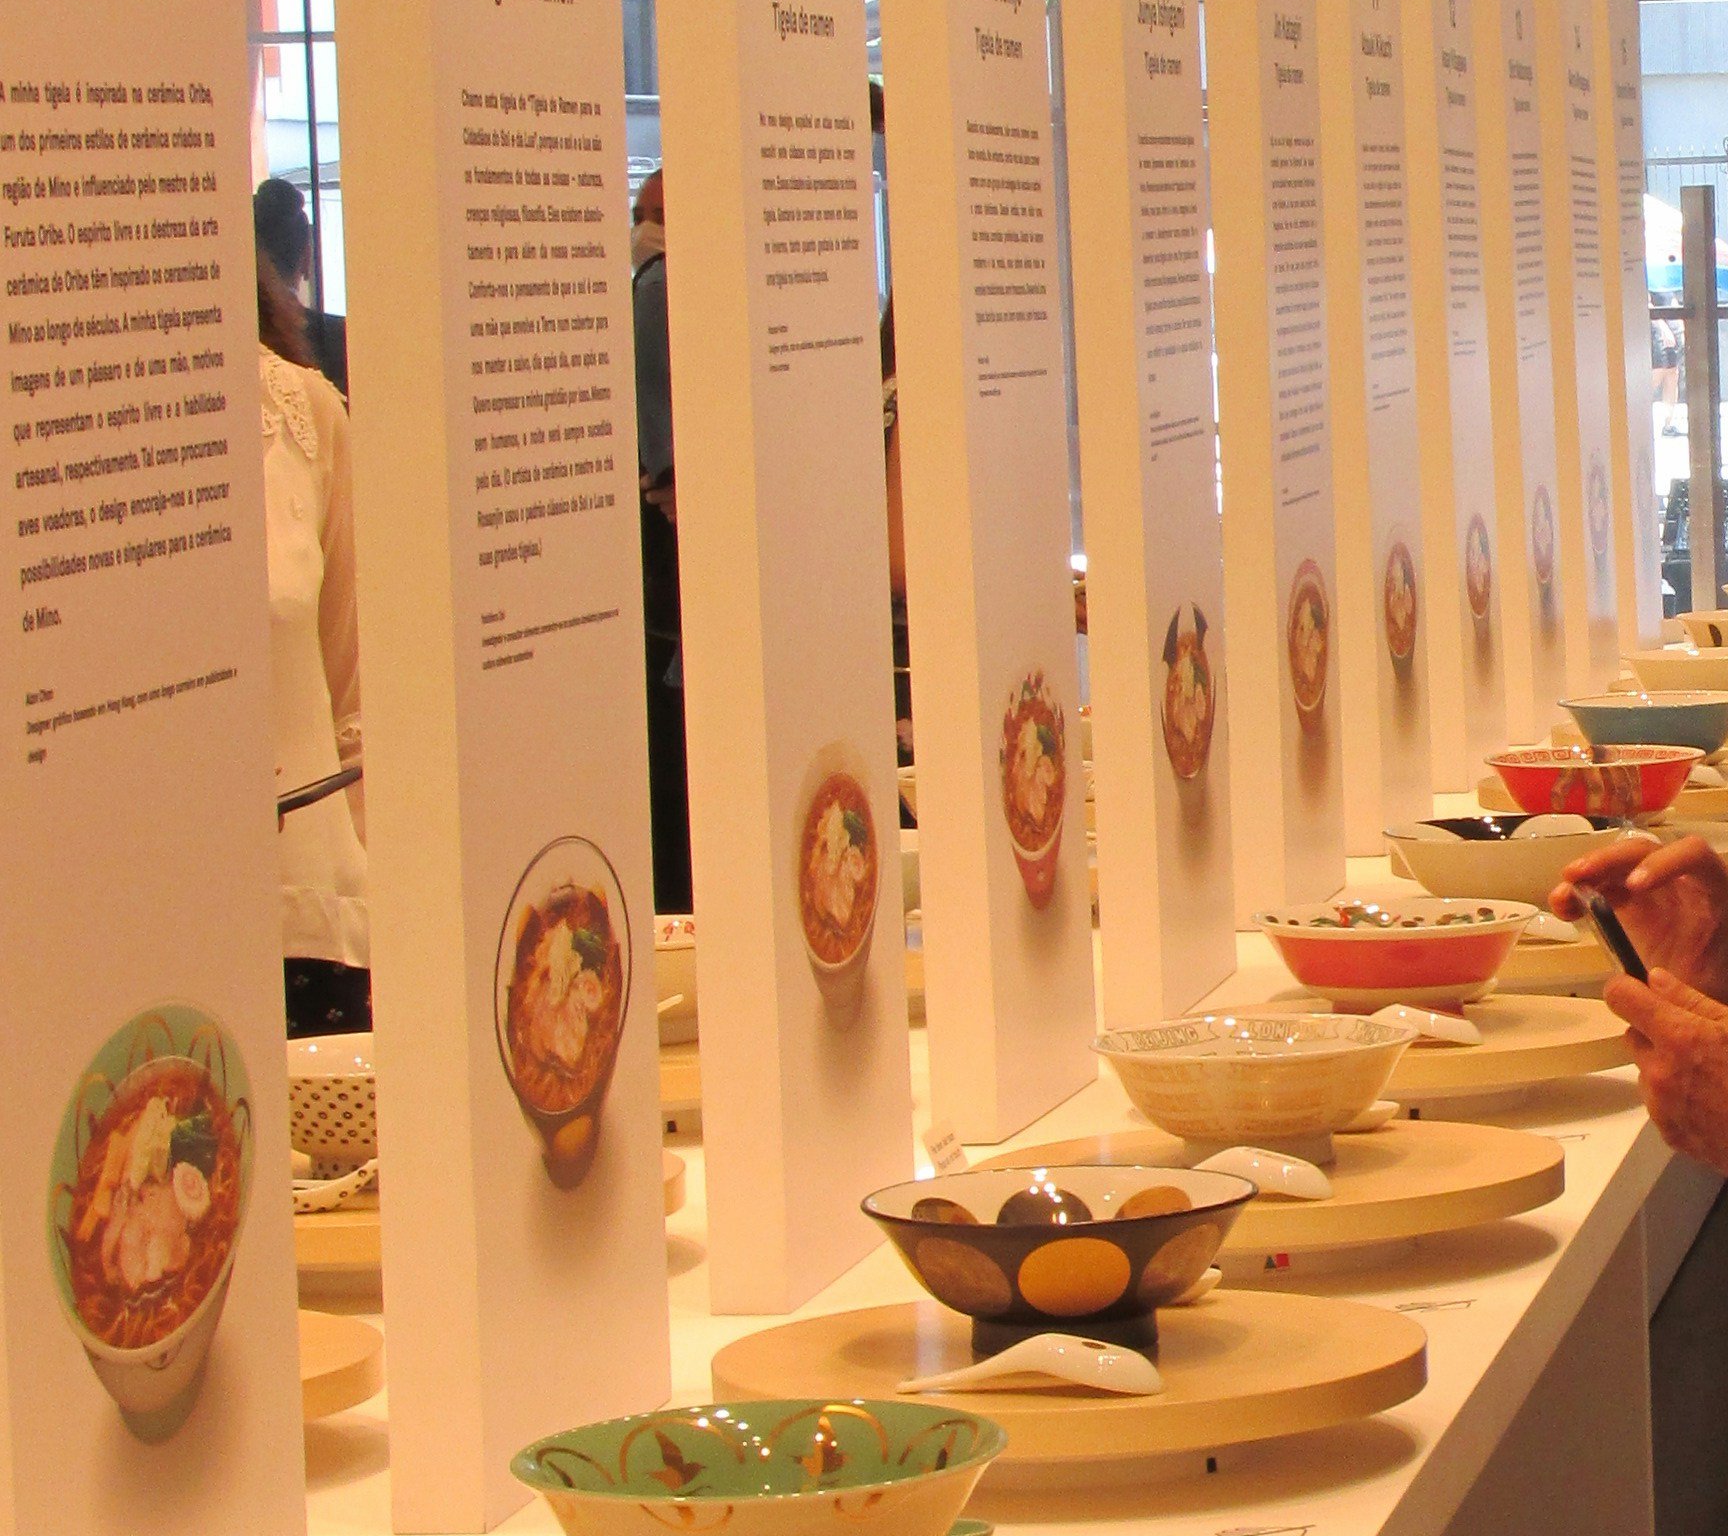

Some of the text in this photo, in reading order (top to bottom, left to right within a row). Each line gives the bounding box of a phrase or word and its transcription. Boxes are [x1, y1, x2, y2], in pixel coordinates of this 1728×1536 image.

[772, 1, 835, 41] Tigela de ramen
